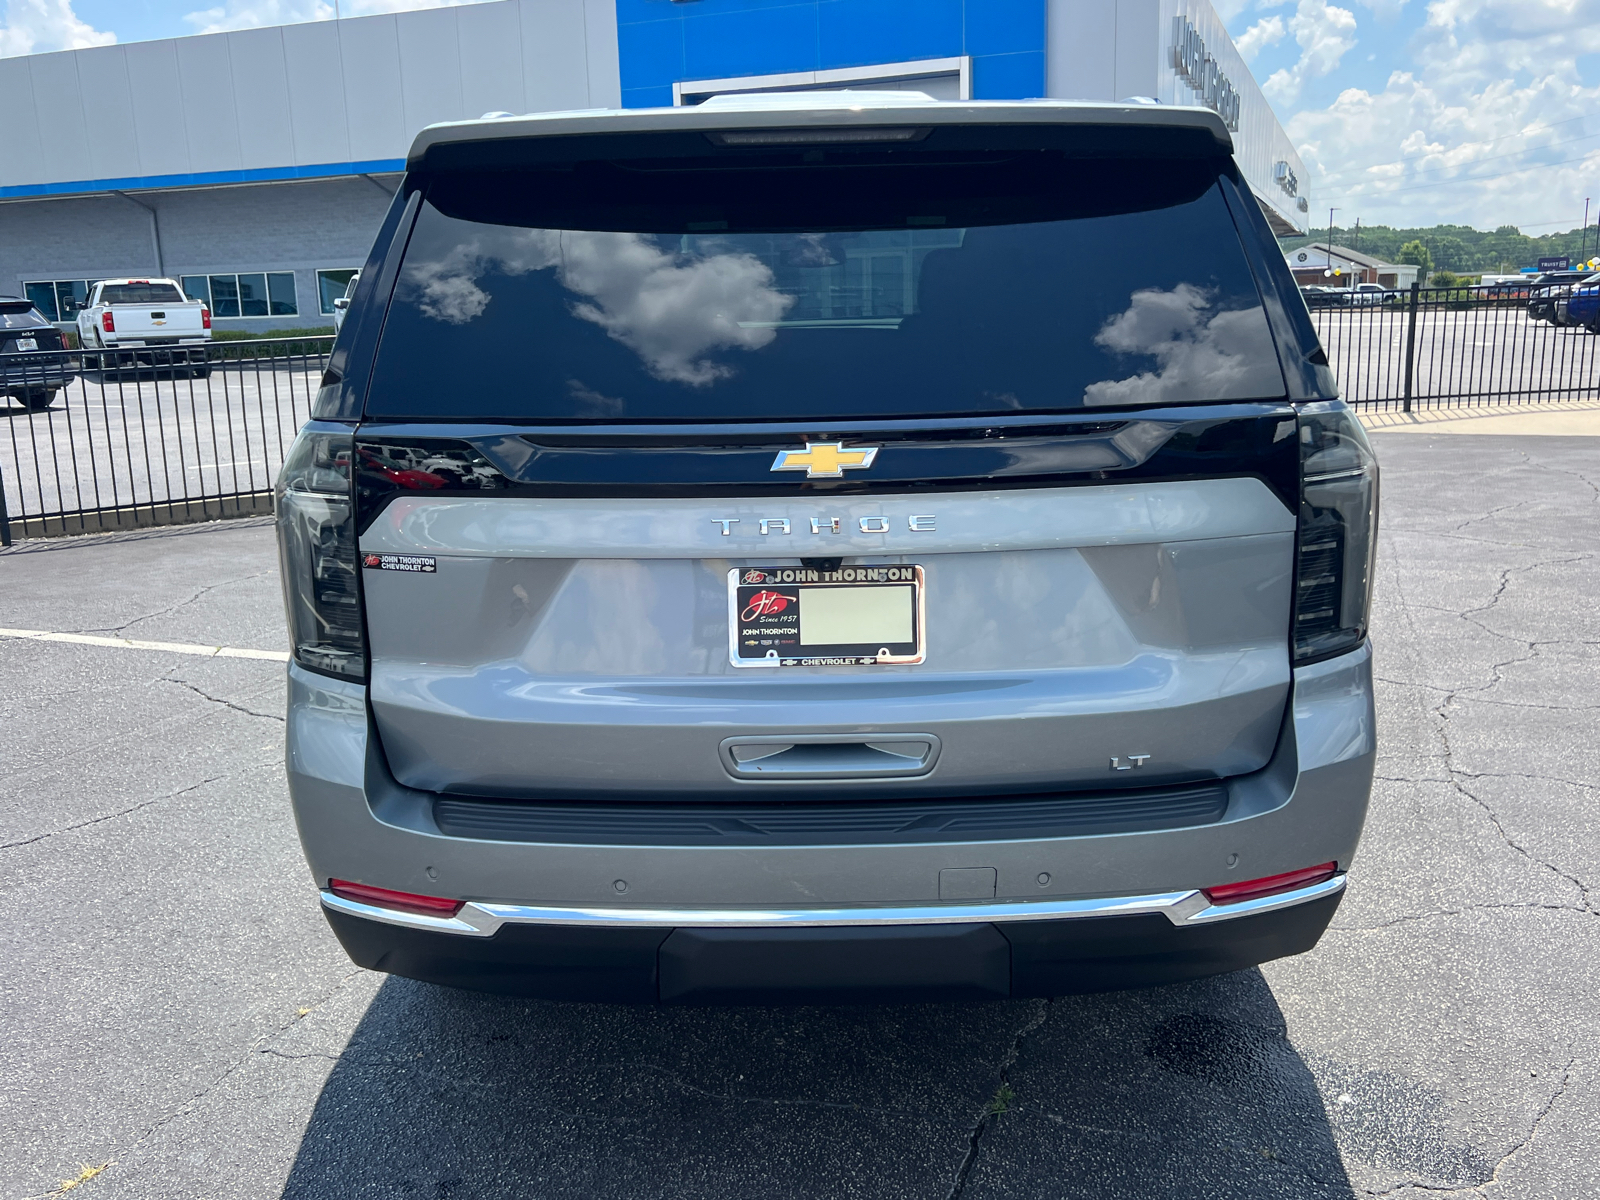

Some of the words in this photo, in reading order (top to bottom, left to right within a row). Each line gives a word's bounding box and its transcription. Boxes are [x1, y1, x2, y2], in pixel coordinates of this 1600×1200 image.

[711, 514, 936, 536] TAHOE
[381, 555, 398, 563] JOHN
[399, 556, 435, 566] THORNTON
[381, 563, 422, 571] CHEVROLET
[774, 570, 819, 583] JOHN
[823, 568, 913, 582] THORNTON
[759, 615, 779, 623] Since
[780, 615, 798, 623] 1957
[742, 628, 760, 636] JOHN
[760, 627, 798, 635] THORNTON
[801, 657, 857, 666] CHEVROLET
[1110, 754, 1151, 771] LT
